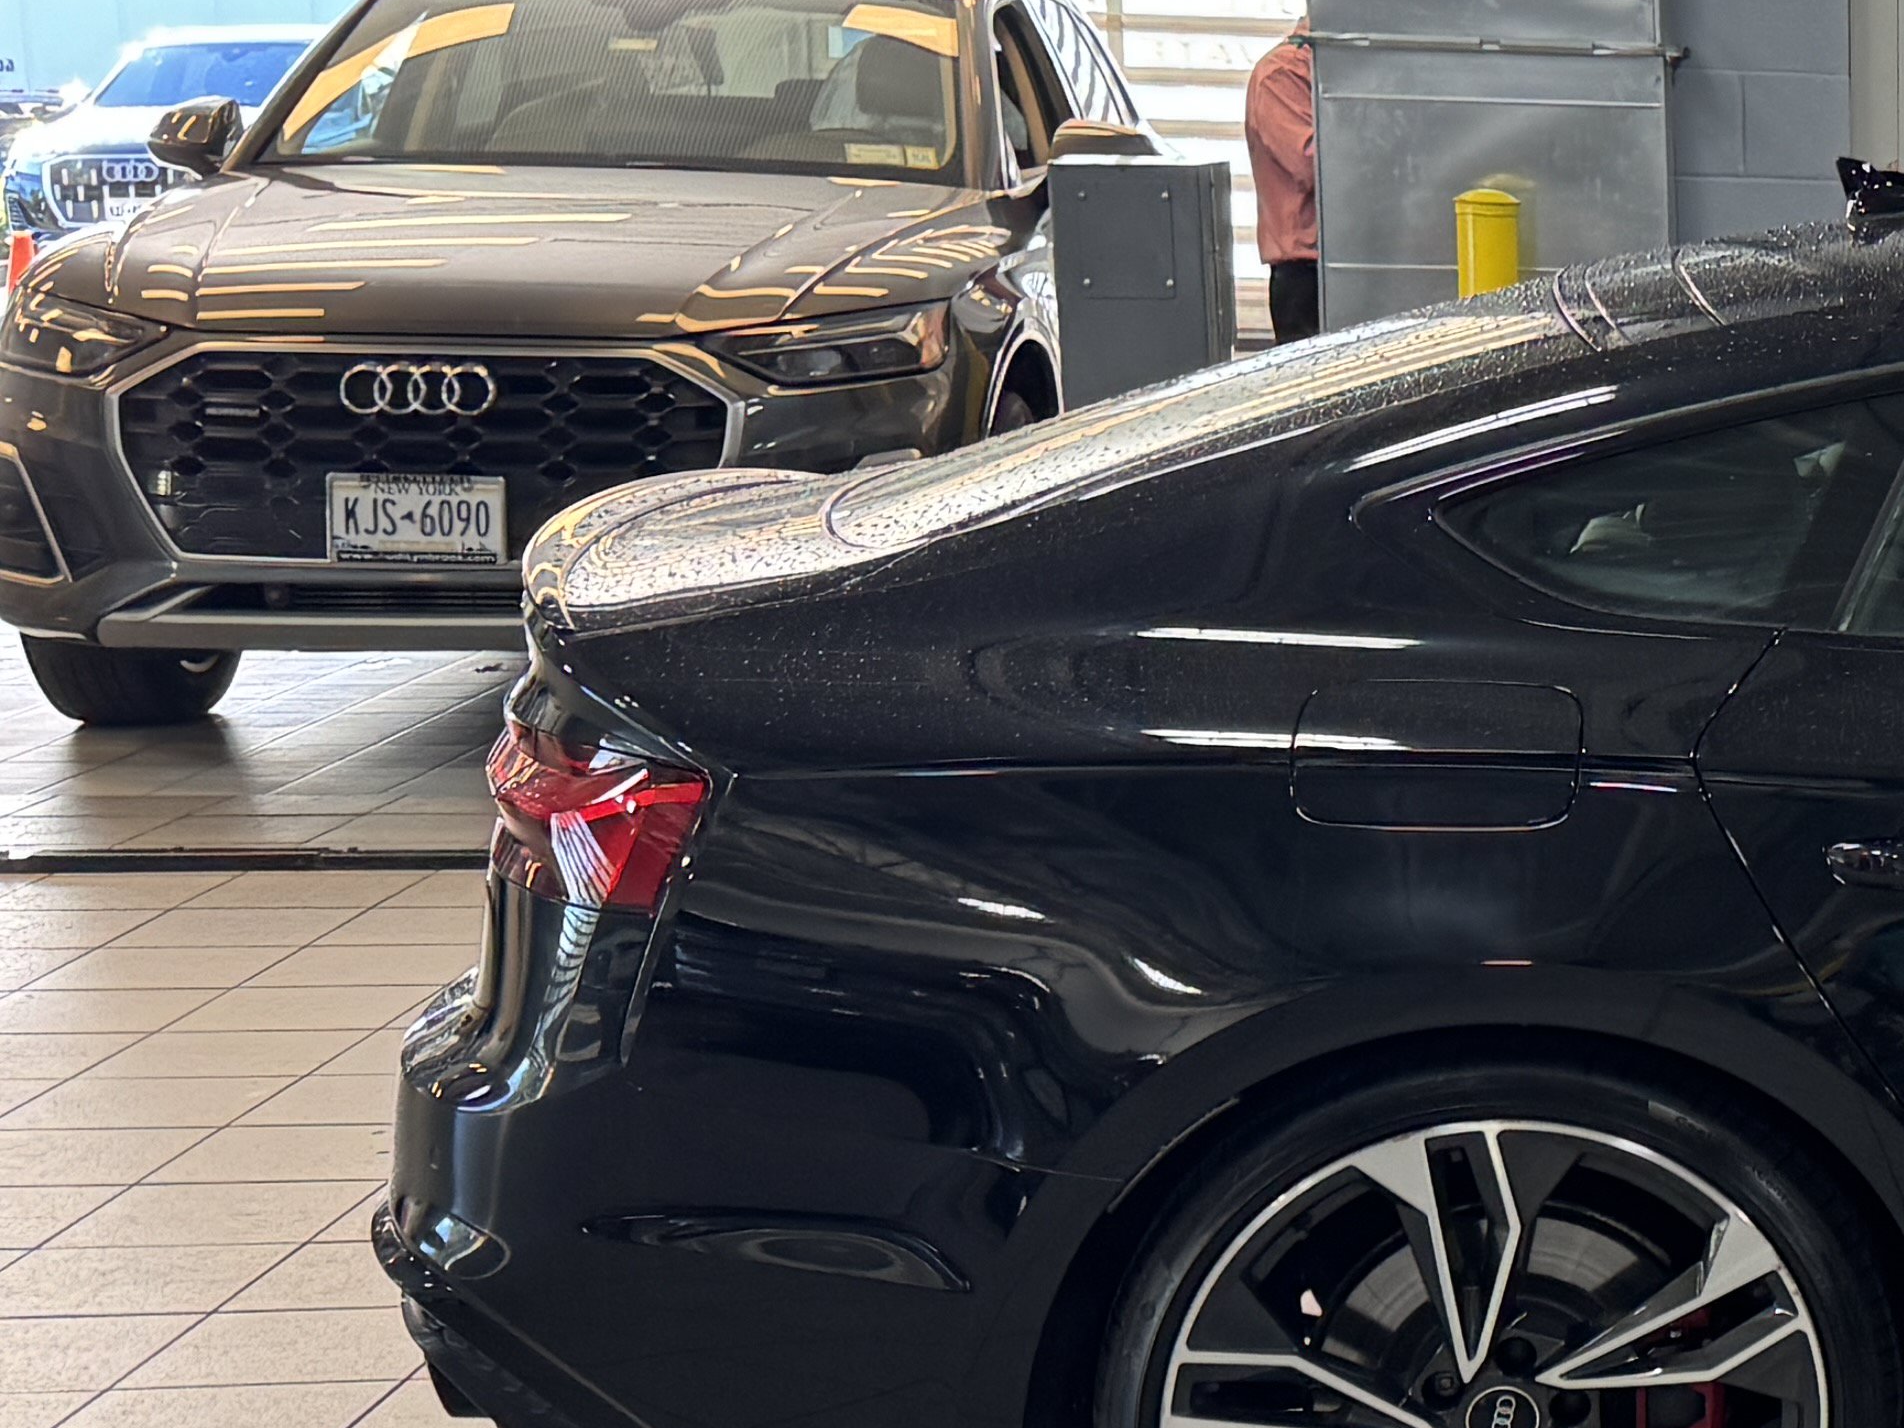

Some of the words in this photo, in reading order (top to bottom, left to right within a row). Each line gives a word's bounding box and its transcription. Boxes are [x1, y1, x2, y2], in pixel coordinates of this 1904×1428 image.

[374, 481, 410, 496] NEW
[417, 482, 460, 497] YORK
[345, 497, 397, 535] KJS
[420, 499, 490, 537] 6090
